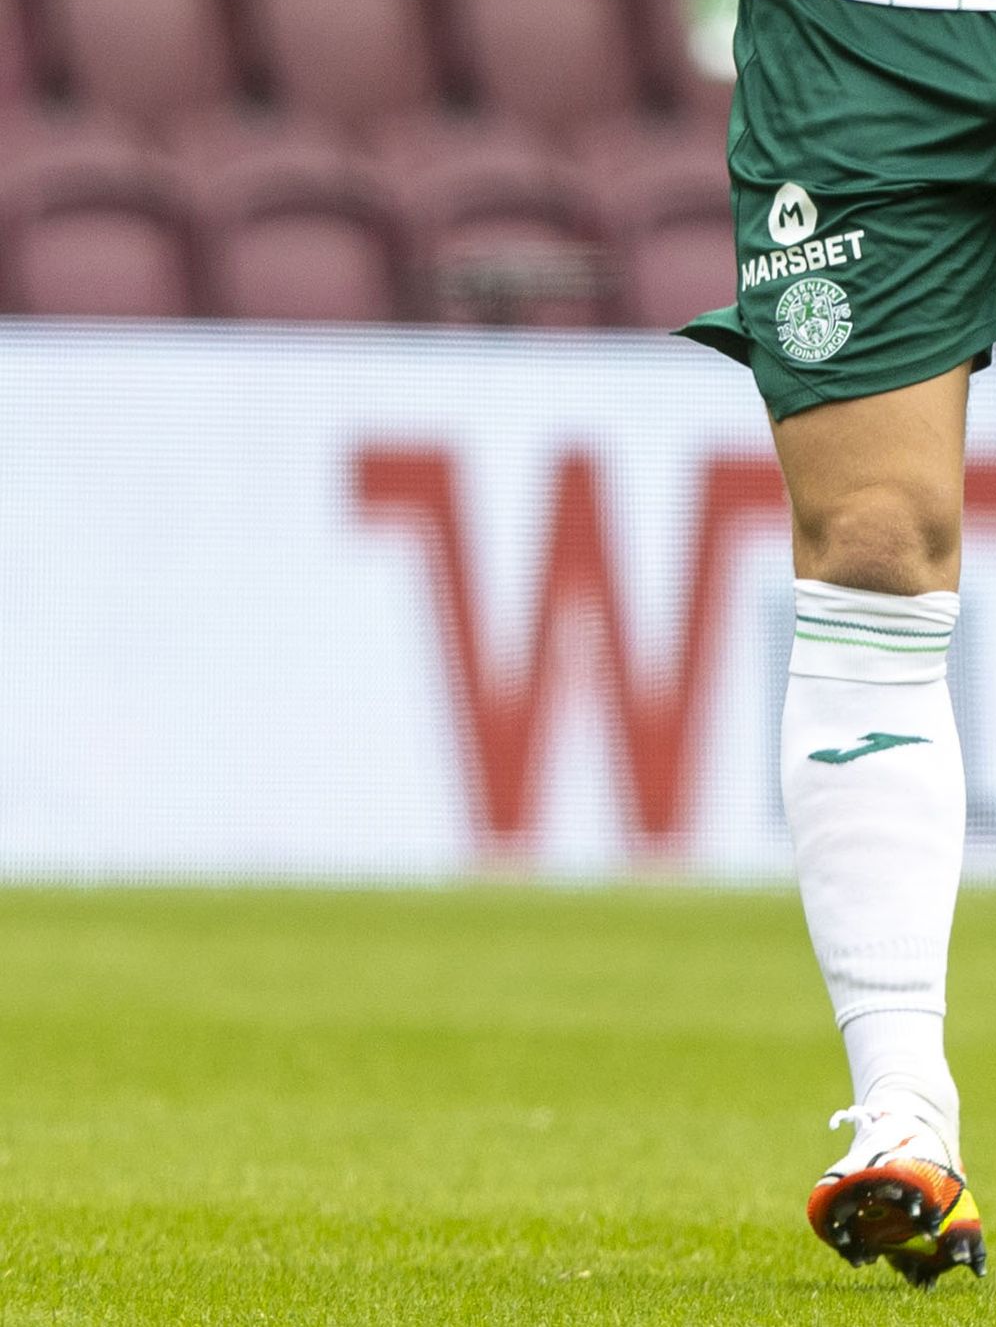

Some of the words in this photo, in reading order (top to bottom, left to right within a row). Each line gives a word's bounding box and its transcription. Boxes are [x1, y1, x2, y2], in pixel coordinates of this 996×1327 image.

[778, 201, 805, 229] M
[742, 229, 865, 292] MARSBET
[779, 281, 841, 316] HIBERNIAN
[788, 328, 848, 359] EDINBURGH
